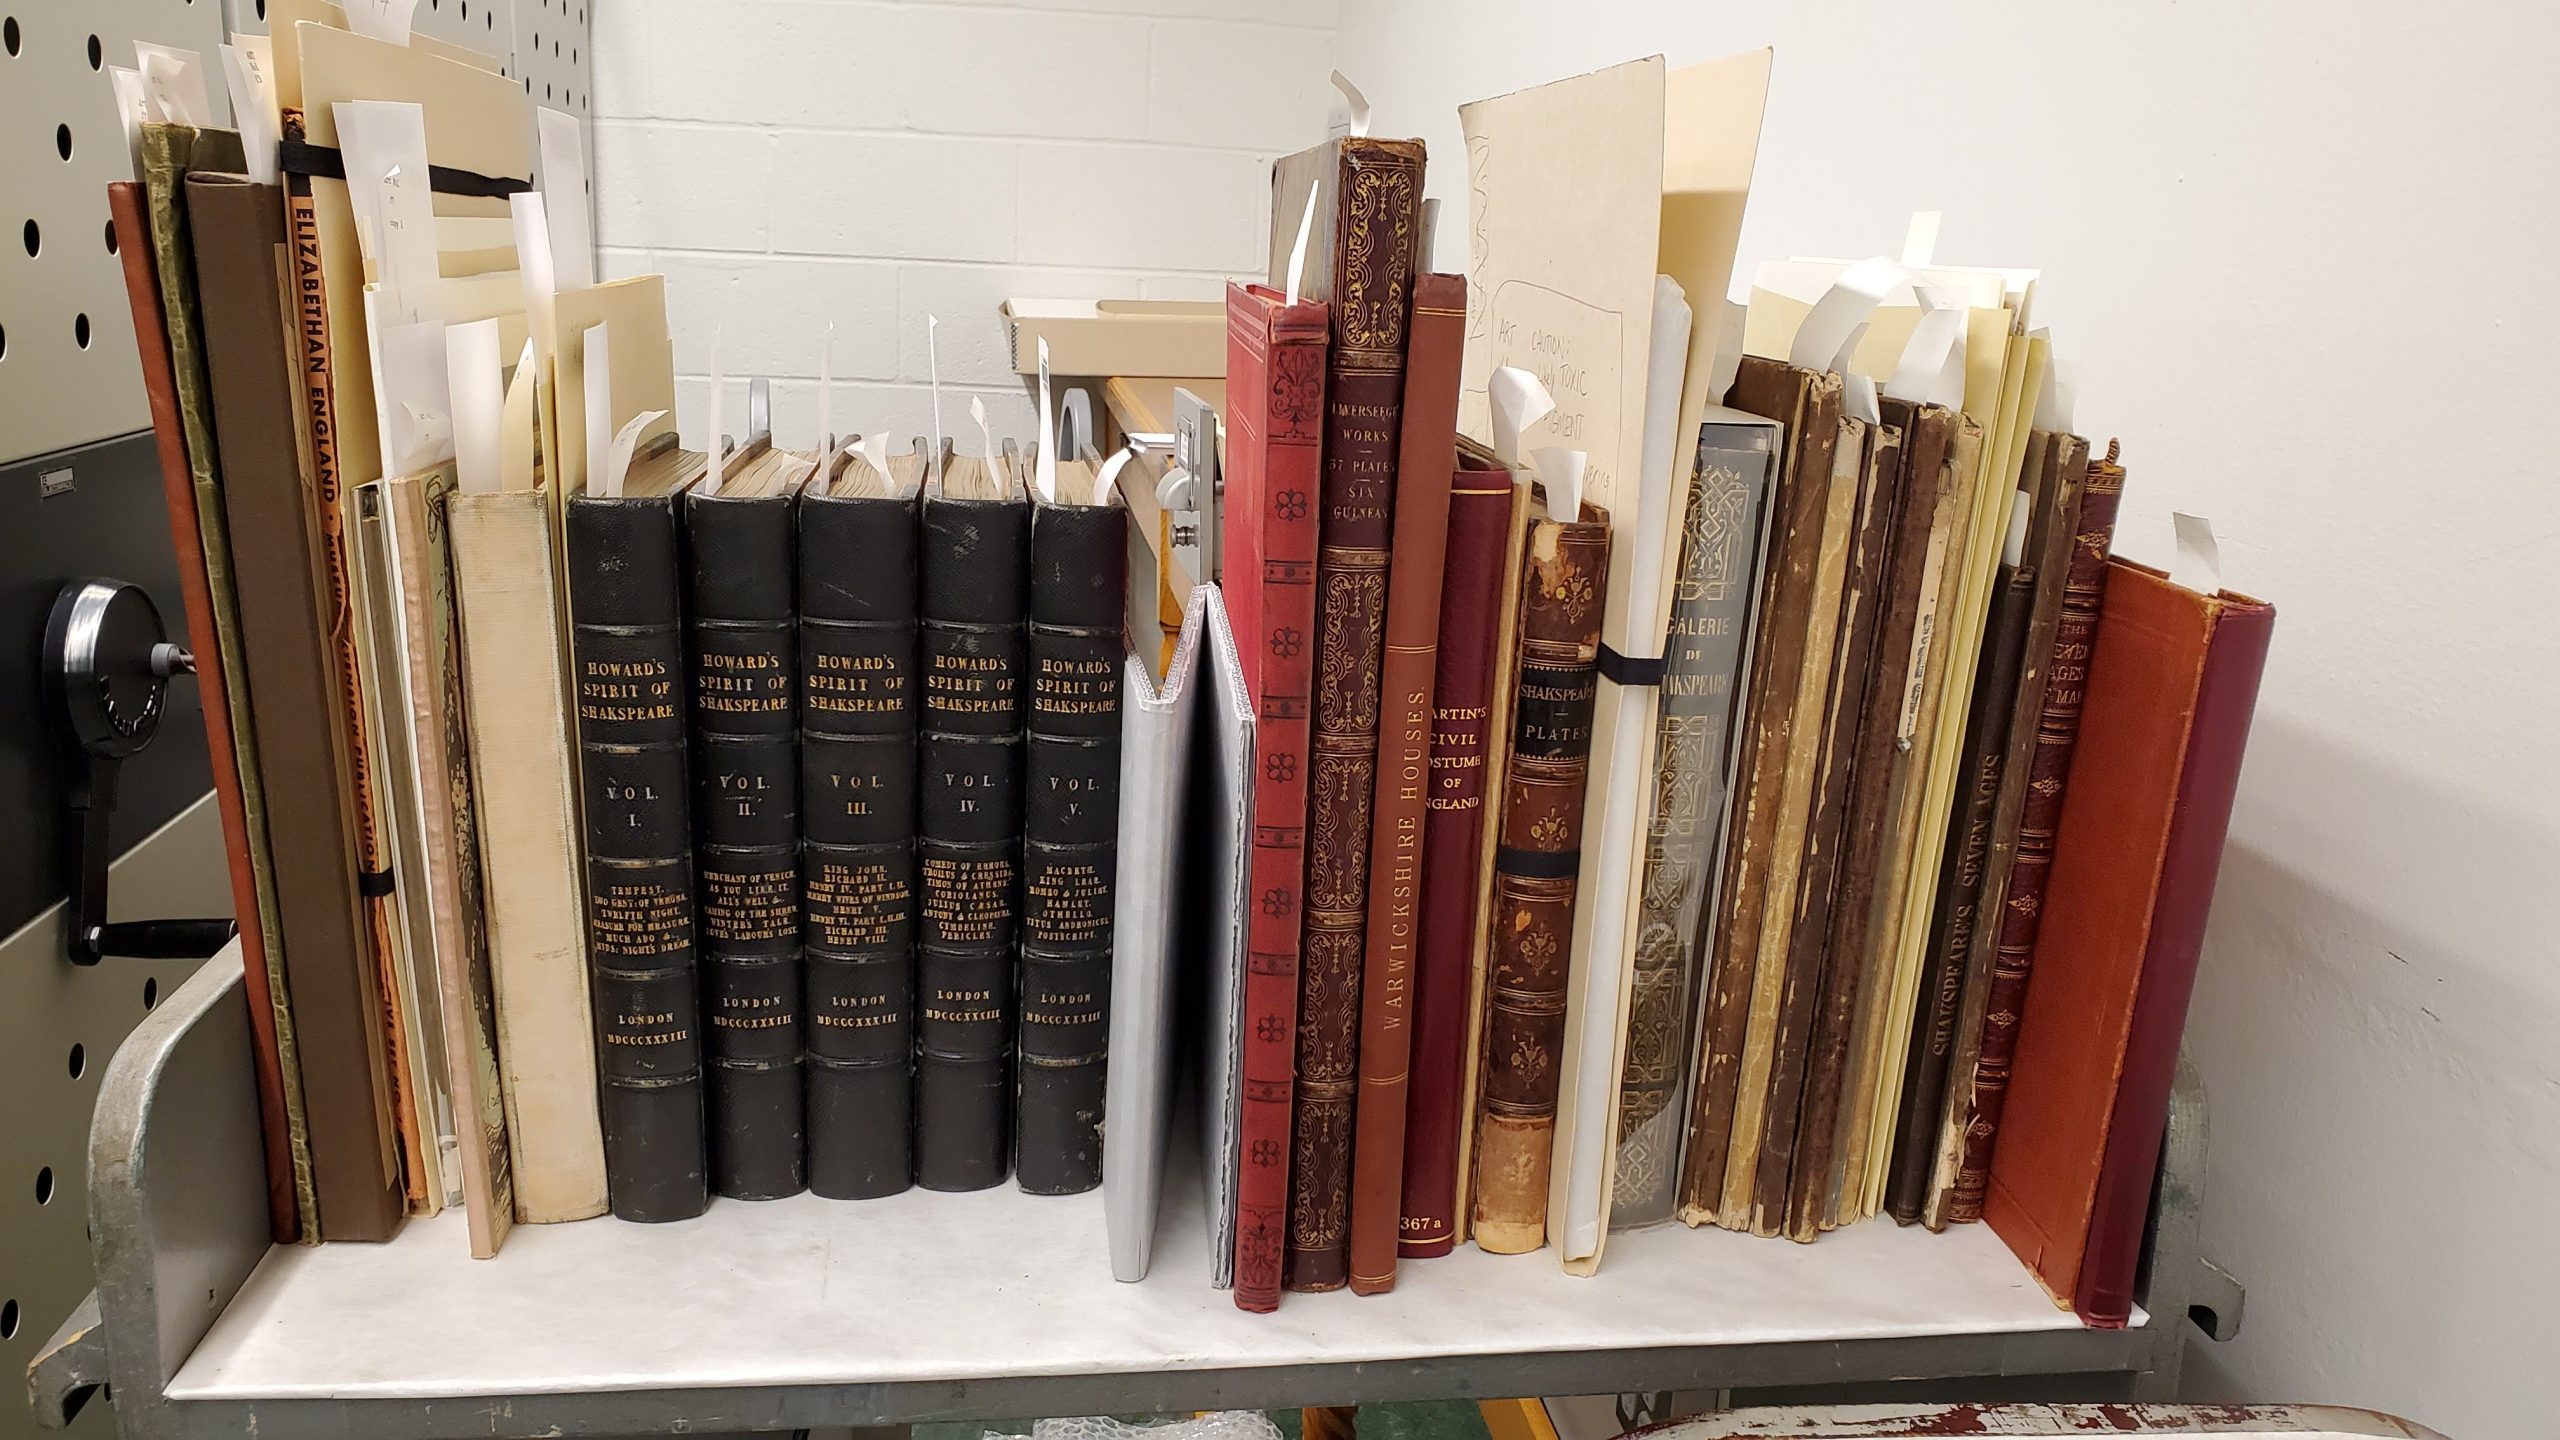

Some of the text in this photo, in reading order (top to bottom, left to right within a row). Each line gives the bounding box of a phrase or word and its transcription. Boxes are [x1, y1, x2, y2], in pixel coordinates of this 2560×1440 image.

[295, 208, 326, 374] ELIZABETHAN
[311, 386, 336, 503] ENGLAND
[1560, 363, 1588, 396] TOXIC
[1343, 429, 1389, 442] WORKS
[1349, 486, 1374, 498] SIX
[2062, 624, 2088, 635] THE
[703, 651, 779, 669] HOWARD'S
[1685, 649, 1702, 660] DE
[588, 658, 666, 676] HOWARD'S
[818, 654, 895, 670] HOWARD'S
[935, 654, 1007, 671] HOWARD'S
[1042, 656, 1111, 674] HOWARD'S
[584, 681, 671, 698] SPIRIT OF
[699, 676, 788, 691] SPIRIT OF
[809, 675, 904, 691] SPIRIT OF
[928, 675, 1015, 692] SPIRIT OF
[1036, 678, 1116, 694] SPIRIT OF
[699, 696, 788, 712] SHAKSPEARE
[810, 696, 904, 712] SHAKSPEARE
[928, 696, 1014, 713] SHAKSPEARE
[1035, 698, 1116, 714] SHAKSPEARE
[581, 704, 674, 720] SHAKSPEARE
[1432, 706, 1487, 720] ARTIN'S
[1429, 733, 1477, 746] CIVIL
[1525, 724, 1588, 741] PLATES
[720, 775, 770, 789] VOL.
[831, 774, 884, 788] VOL.
[945, 774, 996, 788] VOL.
[1050, 778, 1100, 791] VOL.
[1443, 778, 1462, 789] OF
[1975, 753, 2000, 807] AGES
[607, 787, 659, 799] VOL.
[738, 803, 756, 816] II.
[847, 802, 873, 815] III.
[960, 801, 980, 813] IV.
[1069, 803, 1082, 816] V.
[1425, 796, 1480, 810] NGLAND
[629, 814, 642, 827] I.
[1961, 820, 1991, 888] SEVEN
[960, 862, 972, 871] OF
[749, 875, 761, 883] OF
[955, 881, 967, 890] OF
[862, 895, 873, 904] OF
[749, 910, 767, 918] THE
[1383, 817, 1416, 1030] WARWICKSHIRE
[723, 996, 781, 1008] LONDON
[832, 994, 887, 1007] LONDON
[937, 990, 990, 1001] LONDON
[1041, 993, 1091, 1005] LONDON
[618, 1012, 674, 1024] LONDON
[713, 1014, 793, 1029] MDCCCXXXIII
[816, 1013, 897, 1028] MDCCCXXXIII
[925, 1008, 1001, 1022] MDCCCXXXIII
[1026, 1010, 1101, 1025] MDCCCXXXIII
[607, 1030, 688, 1046] MDCCCXXXIII
[1400, 1217, 1442, 1230] 367 a
